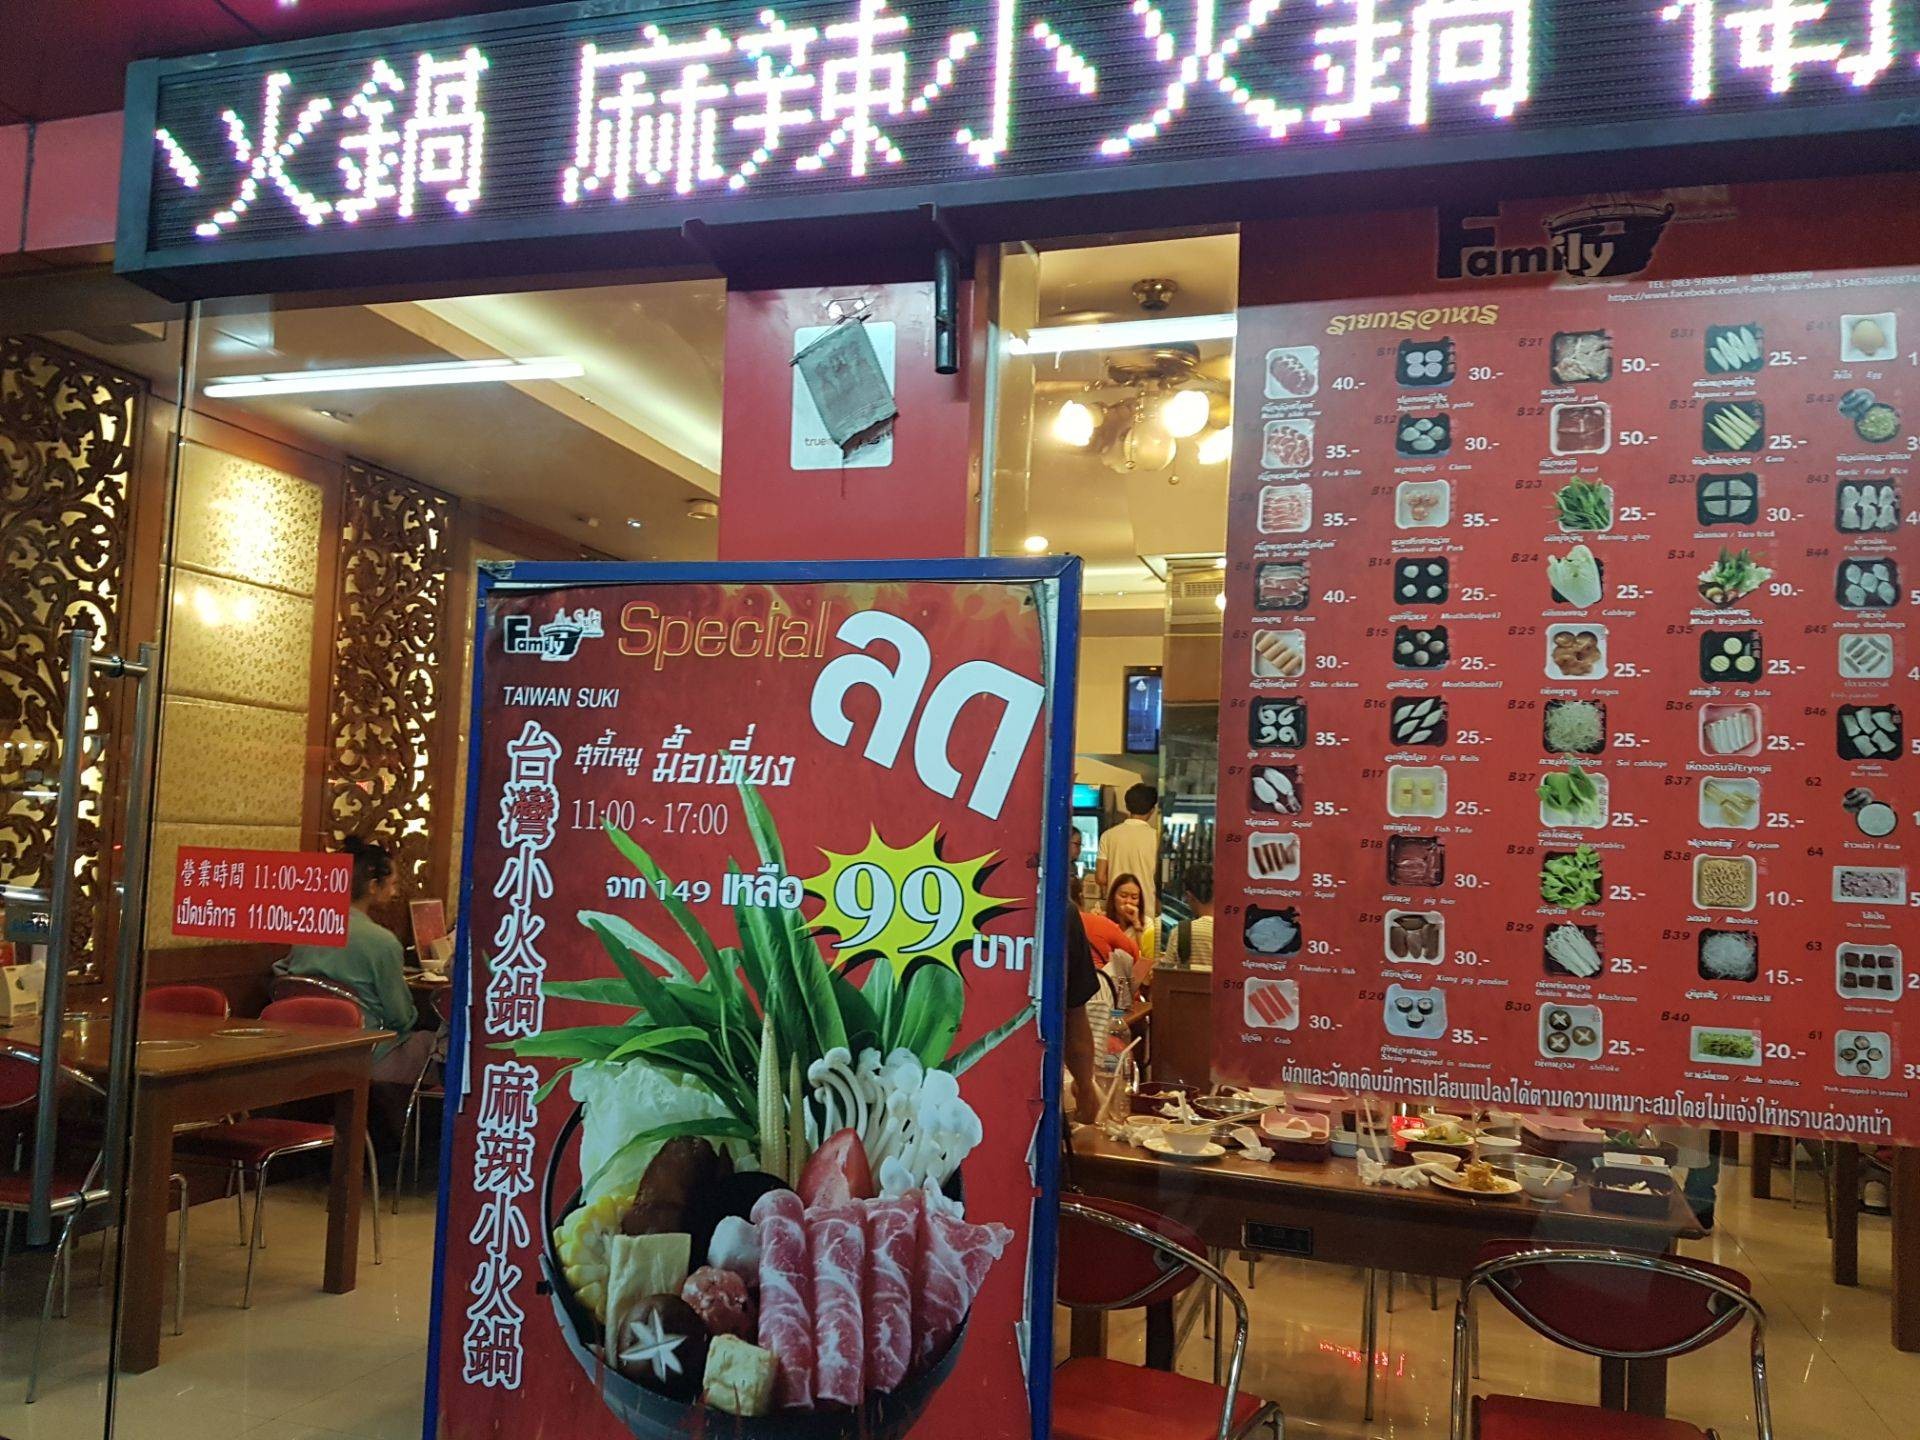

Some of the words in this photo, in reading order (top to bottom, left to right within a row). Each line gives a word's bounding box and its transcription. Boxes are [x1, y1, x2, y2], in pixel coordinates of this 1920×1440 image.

[154, 48, 489, 236] 火鍋
[1436, 203, 1614, 279] Family
[1326, 304, 1499, 335] รายการอาหาร
[505, 615, 566, 656] Family
[618, 600, 831, 671] Special
[503, 686, 571, 706] TAIWAN
[576, 688, 619, 707] SUKI
[809, 608, 1045, 821] ลด
[571, 799, 635, 831] 11:00
[663, 802, 728, 835] 17:00
[181, 858, 245, 889] 營業時間
[254, 865, 350, 894] 11:00~23:00
[484, 719, 563, 1037] 台灣小火鍋
[605, 875, 646, 899] จาก
[655, 879, 711, 903] 149
[721, 863, 804, 911] เหลือ
[176, 895, 237, 928] เปิดบริการ
[247, 902, 346, 935] 11.00น-23.00น
[830, 860, 966, 954] 99
[971, 930, 1034, 970] บาท
[462, 1061, 540, 1391] 麻辣小火鍋
